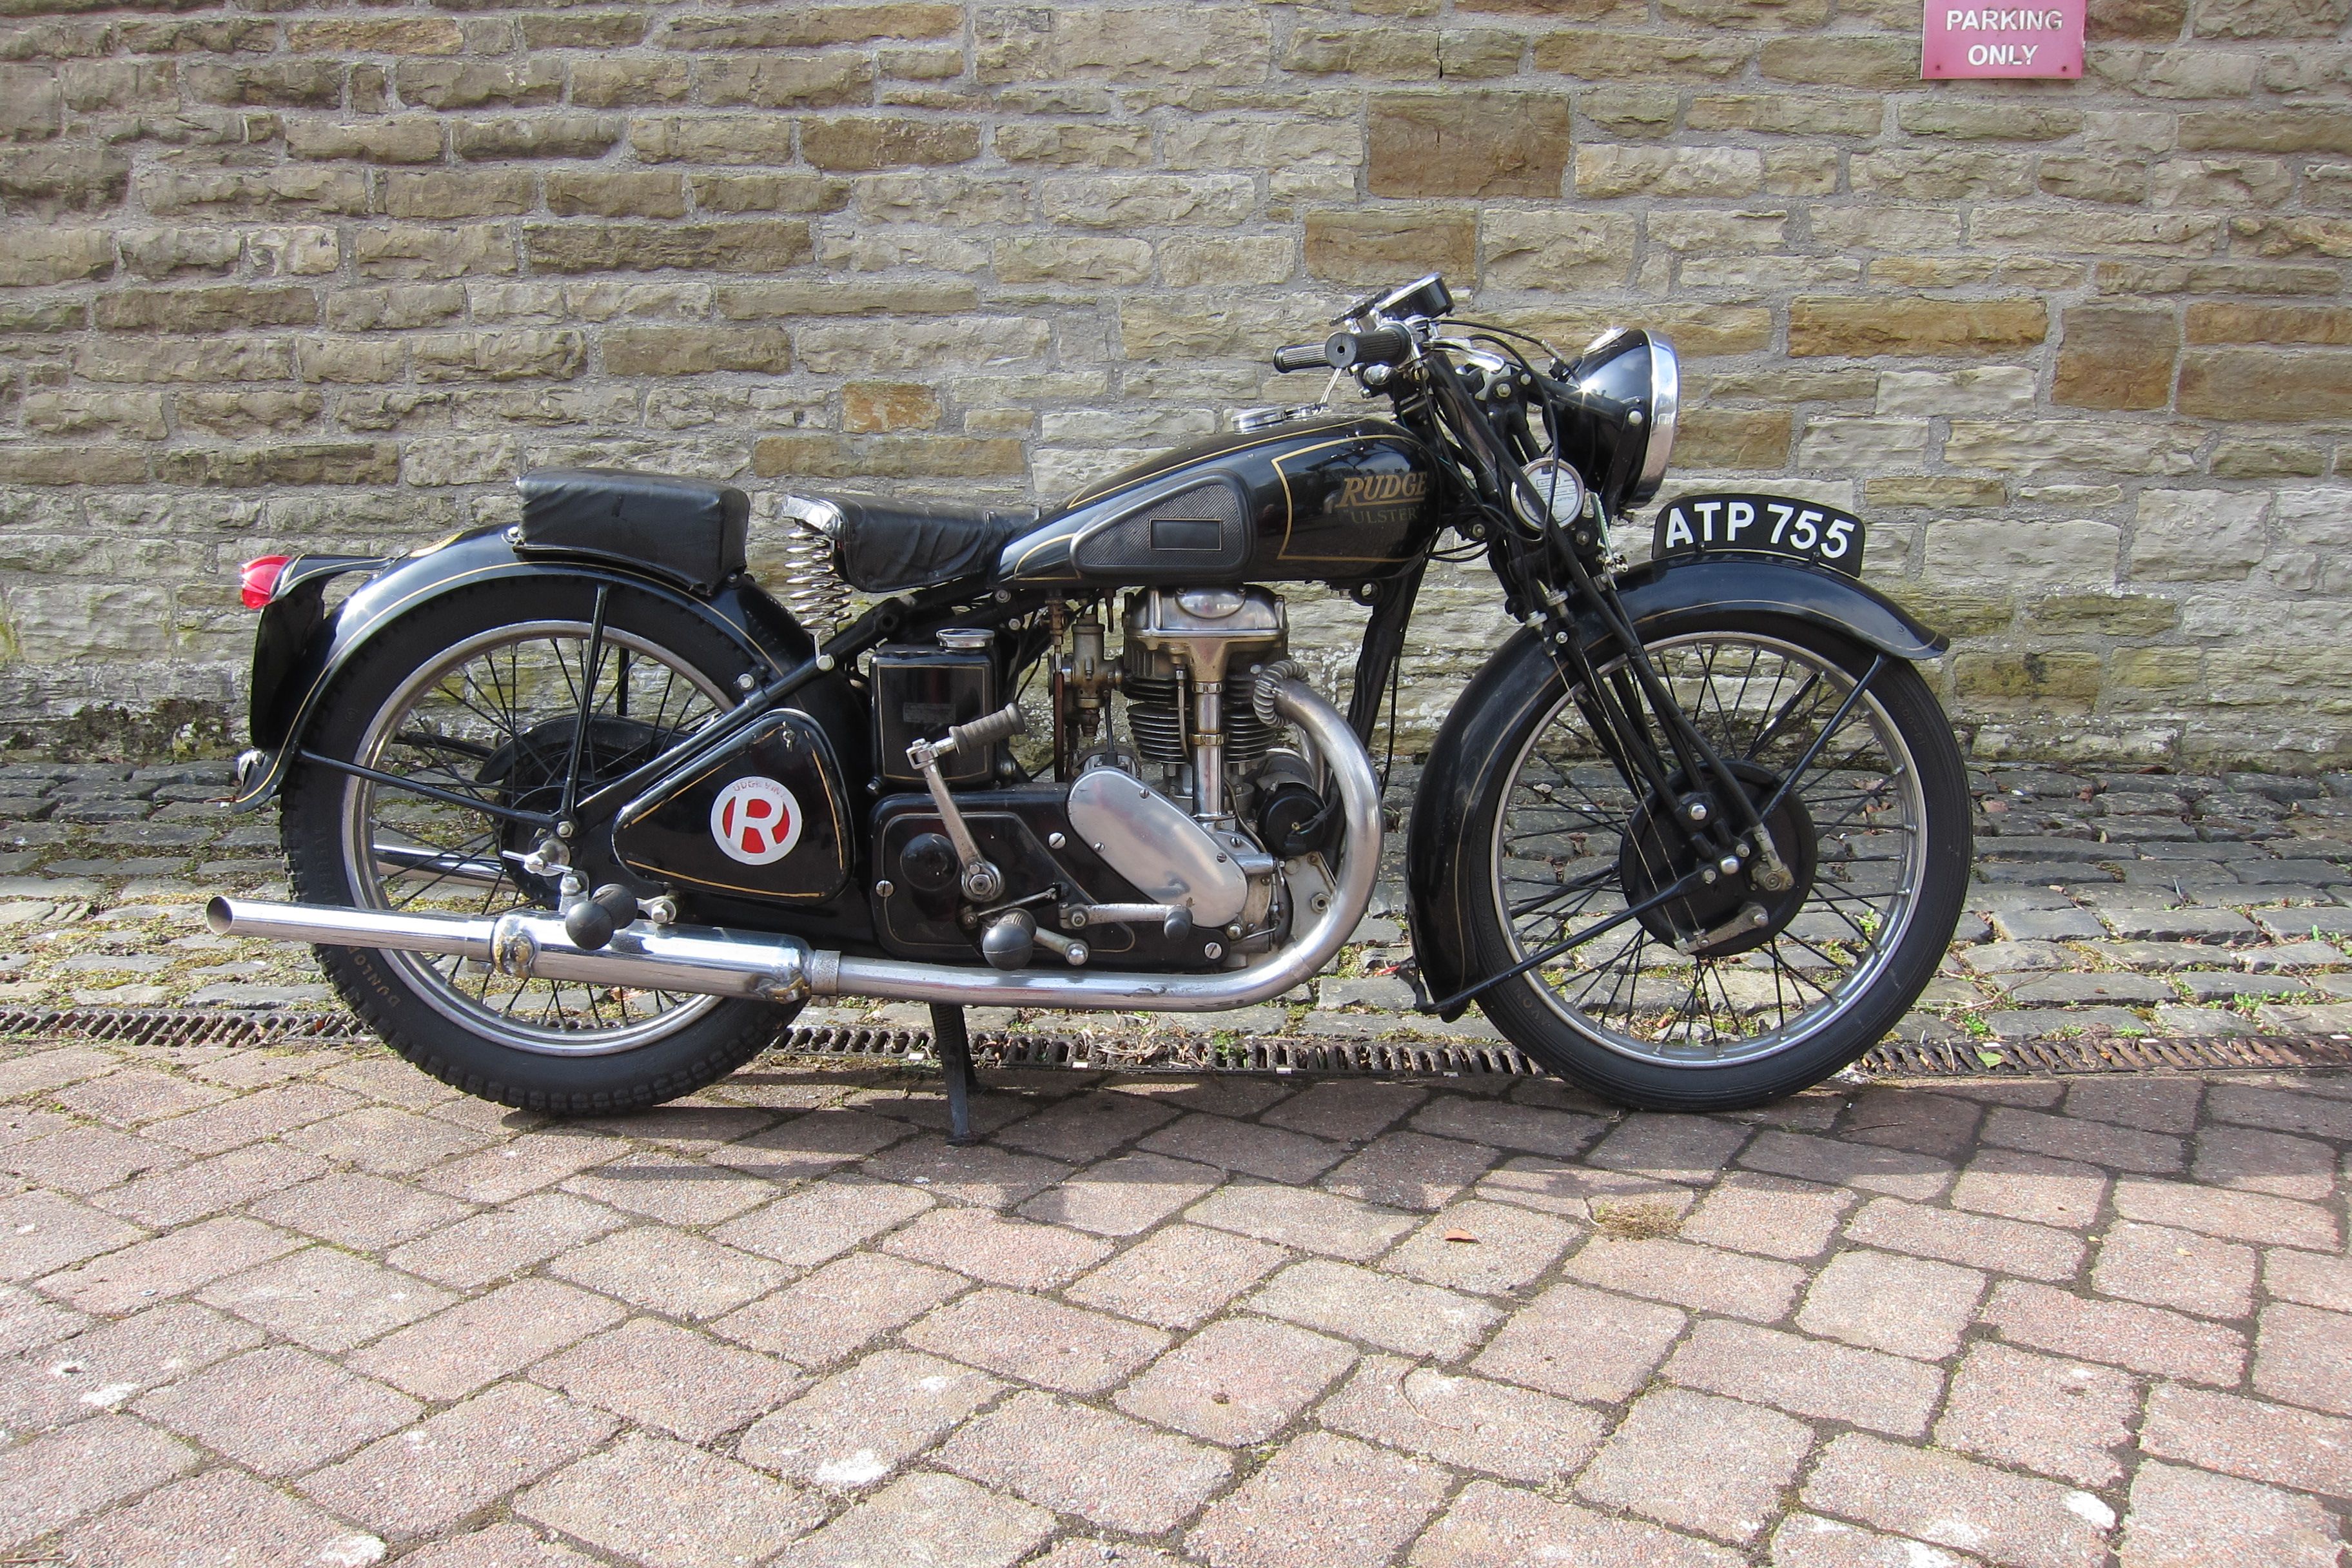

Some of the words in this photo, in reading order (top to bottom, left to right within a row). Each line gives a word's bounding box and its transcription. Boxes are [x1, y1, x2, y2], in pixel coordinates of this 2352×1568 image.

[1946, 9, 2063, 31] PARKING
[1968, 44, 2039, 66] ONLY
[1335, 471, 1427, 508] RUDGE
[1665, 502, 1756, 548] ATP
[1767, 504, 1856, 559] 755
[730, 796, 785, 855] R
